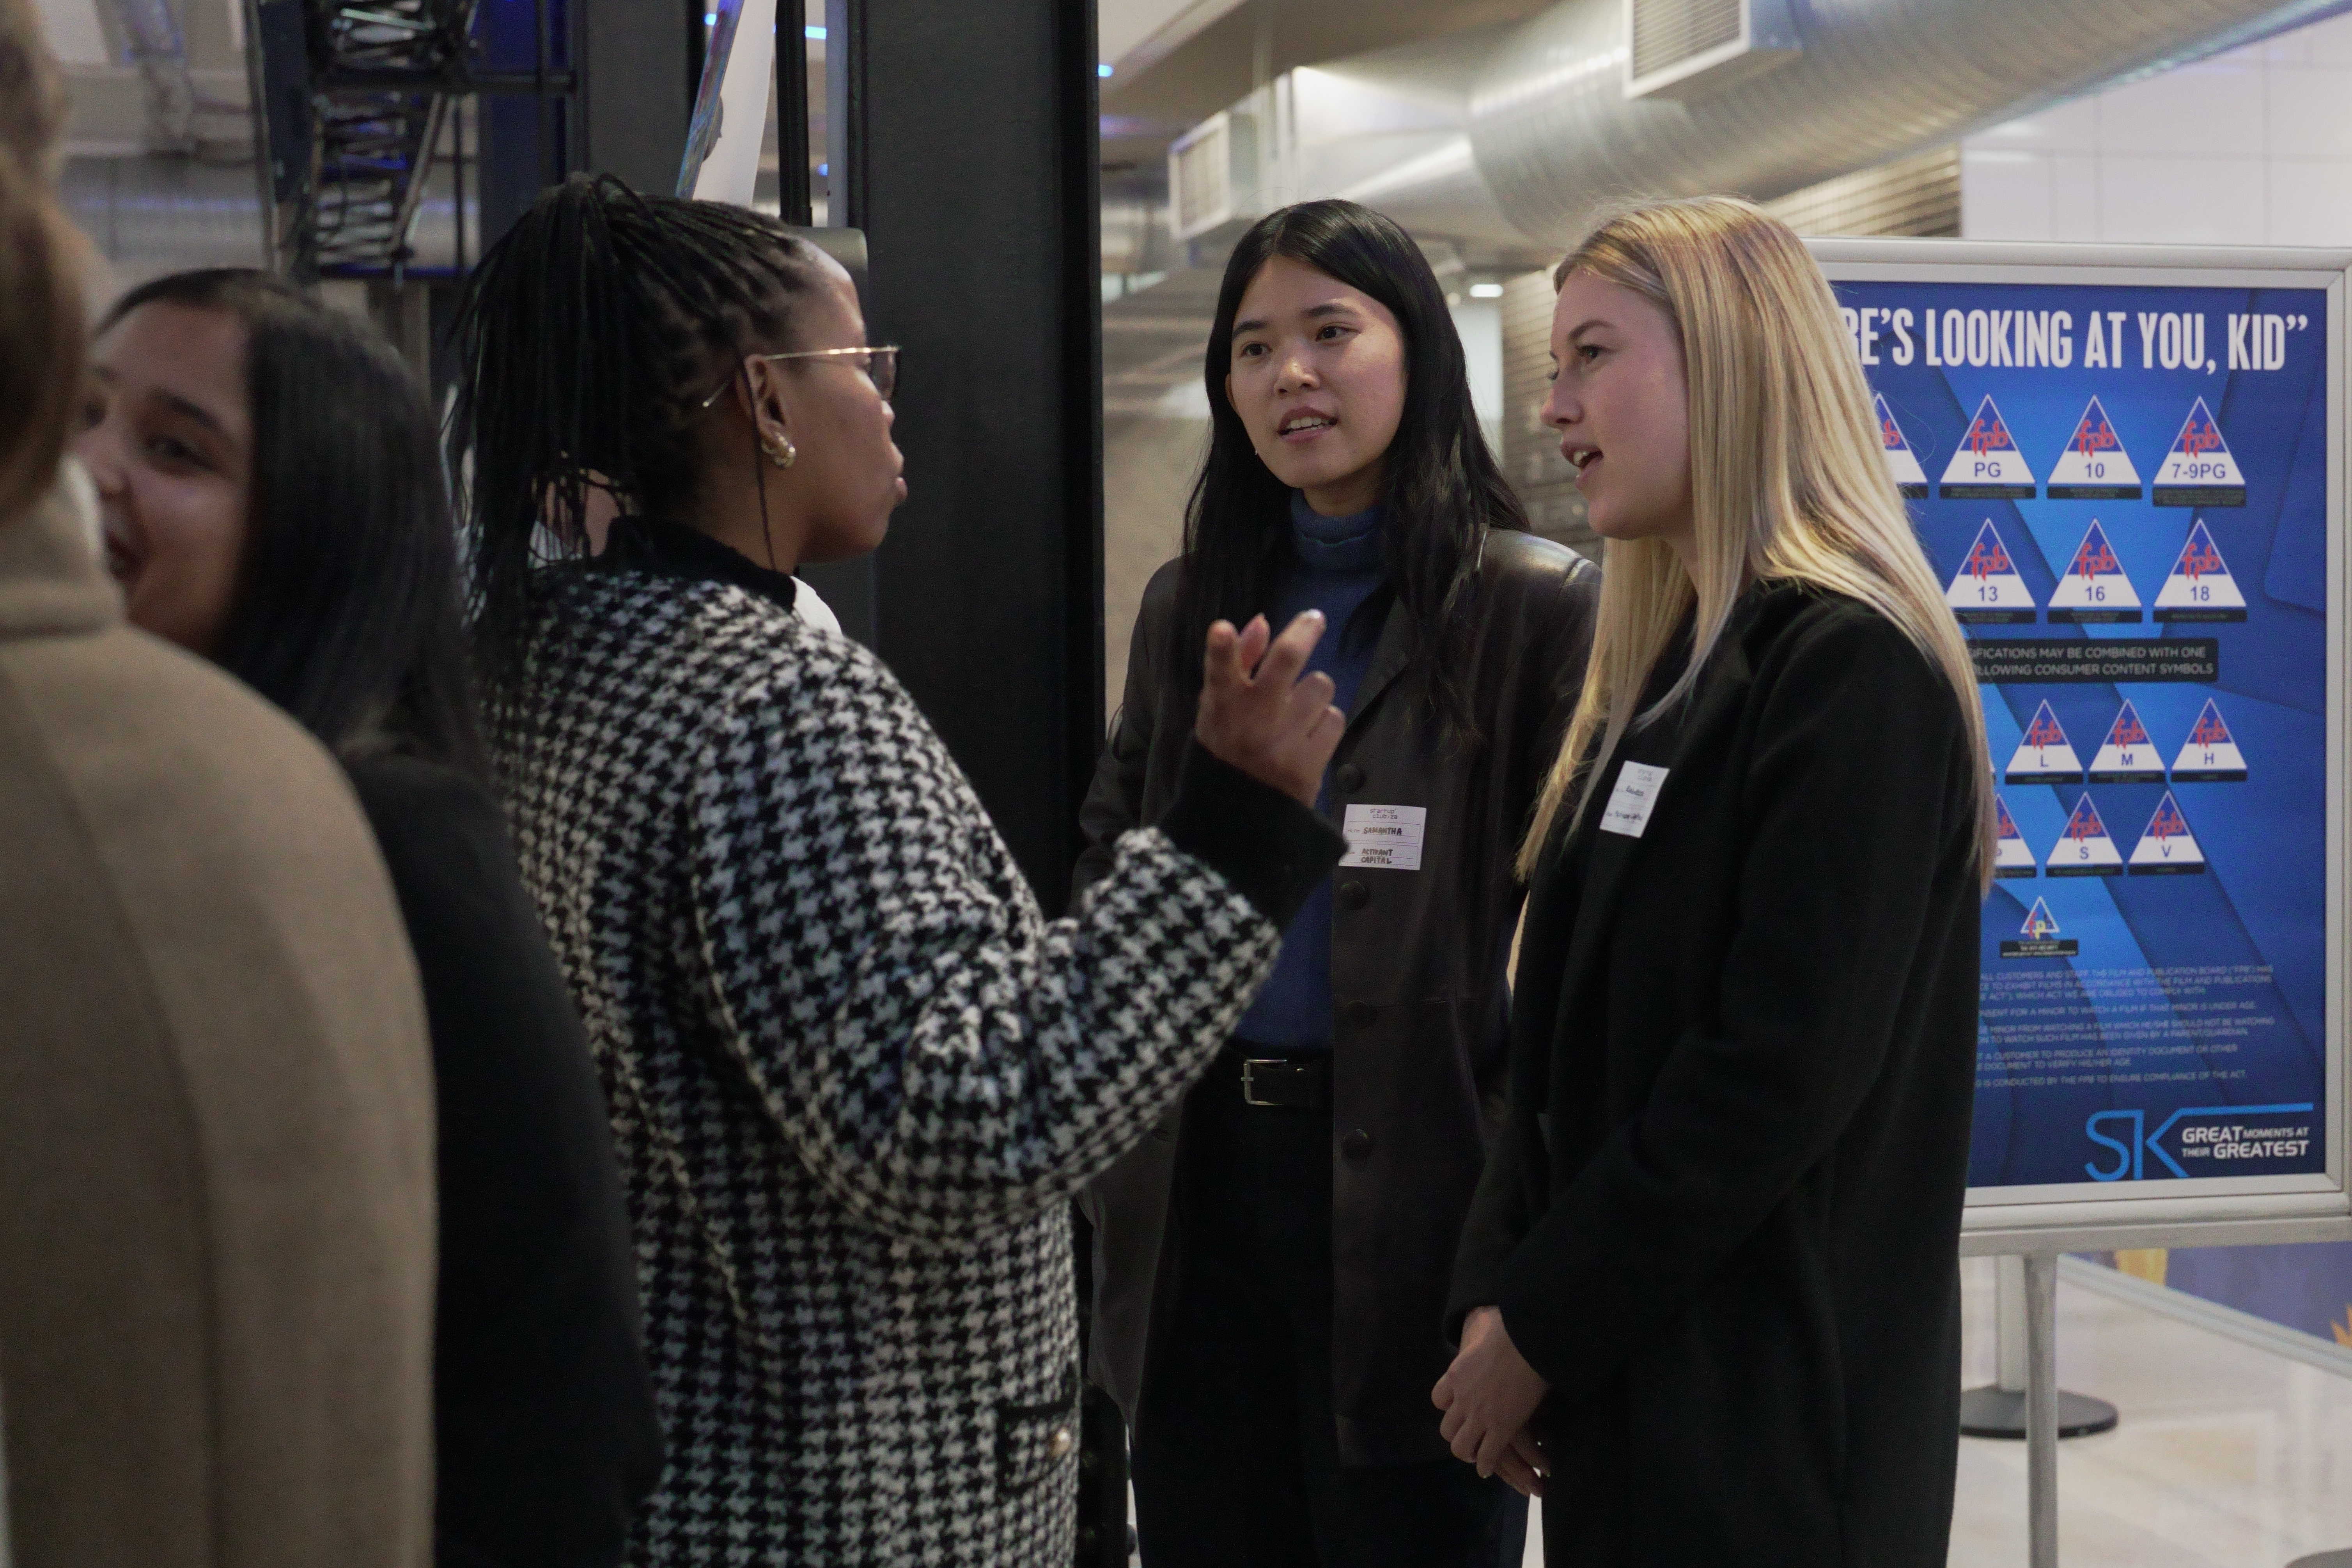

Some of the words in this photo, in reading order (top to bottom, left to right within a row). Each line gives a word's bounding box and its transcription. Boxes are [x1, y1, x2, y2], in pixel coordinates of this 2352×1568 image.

[1926, 308, 2072, 367] LOOKING
[2084, 311, 2127, 368] AT
[2138, 312, 2216, 375] YOU,
[2228, 314, 2308, 370] KID”
[1974, 462, 2001, 477] PG
[2086, 463, 2104, 478] 10
[2173, 464, 2226, 478] 7-9PG
[1978, 586, 1998, 601] 13
[2086, 586, 2105, 601] 16
[2191, 586, 2209, 601] 18
[2040, 648, 2065, 658] MAY
[2068, 648, 2082, 659] BE
[2085, 647, 2146, 659] COMBINED
[2148, 647, 2178, 658] WITH
[2181, 647, 2206, 658] ONE
[2035, 664, 2100, 675] CONSUMER
[2102, 663, 2156, 675] CONTENT
[2159, 663, 2214, 675] SYMBOLS
[2040, 755, 2049, 767] L
[2122, 753, 2133, 765] M
[2204, 753, 2214, 765] H
[2080, 847, 2089, 859] S
[2161, 845, 2171, 858] V
[2182, 1126, 2243, 1143] GREAT
[2243, 1128, 2294, 1138] MOMENTS
[2295, 1127, 2309, 1136] AT
[2182, 1147, 2210, 1157] THEIR
[2214, 1140, 2309, 1159] GREATEST
